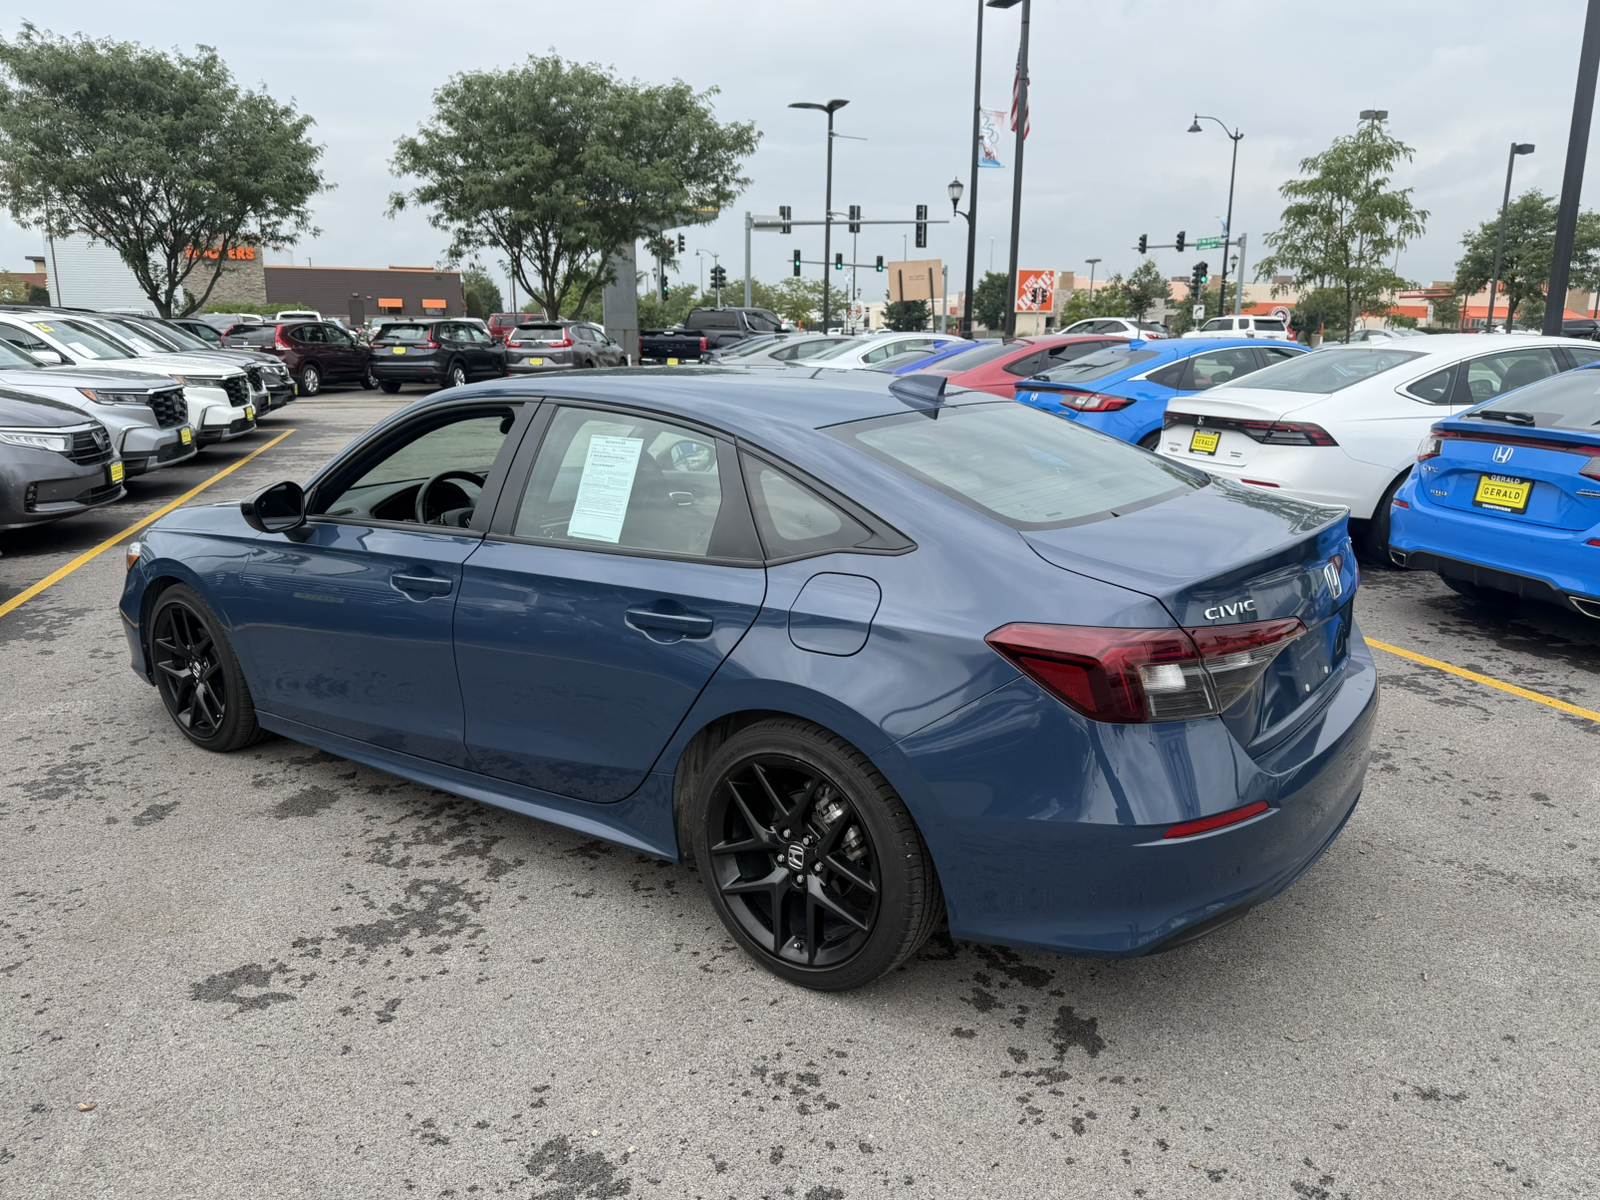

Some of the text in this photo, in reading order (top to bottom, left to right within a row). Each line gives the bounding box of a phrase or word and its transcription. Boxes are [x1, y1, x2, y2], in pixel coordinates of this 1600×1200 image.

[1020, 274, 1038, 291] THE
[1194, 438, 1215, 447] GERALD
[1490, 474, 1521, 485] GERALD
[1483, 487, 1521, 500] GERALD
[1203, 599, 1257, 620] CIVIC
